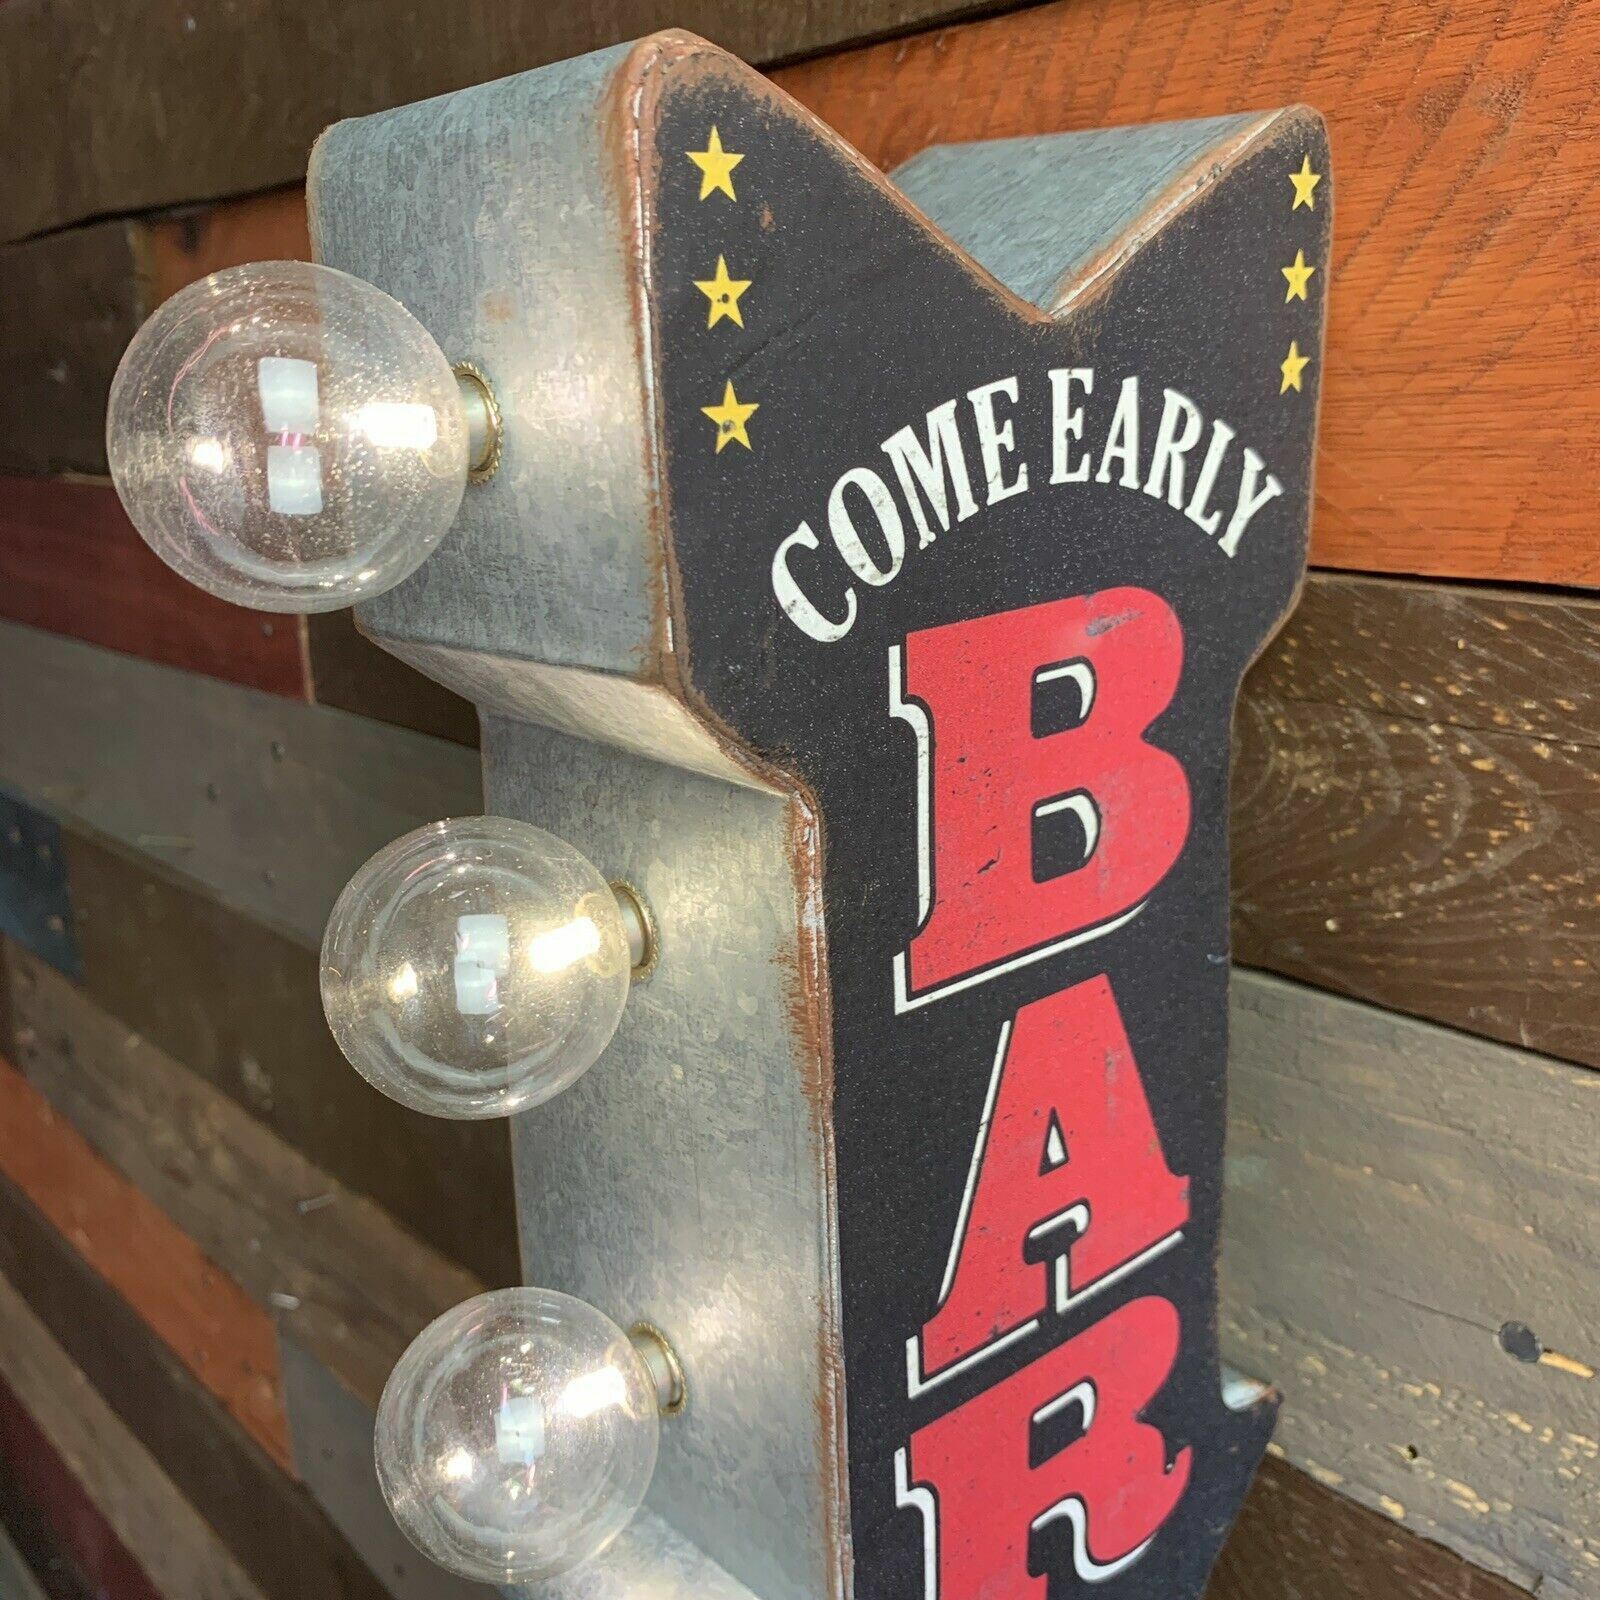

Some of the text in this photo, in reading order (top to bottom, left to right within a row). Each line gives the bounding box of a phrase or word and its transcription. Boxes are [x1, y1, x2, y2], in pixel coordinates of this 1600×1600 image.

[771, 367, 1283, 643] COME EARLY
[890, 586, 1193, 1600] BAR
